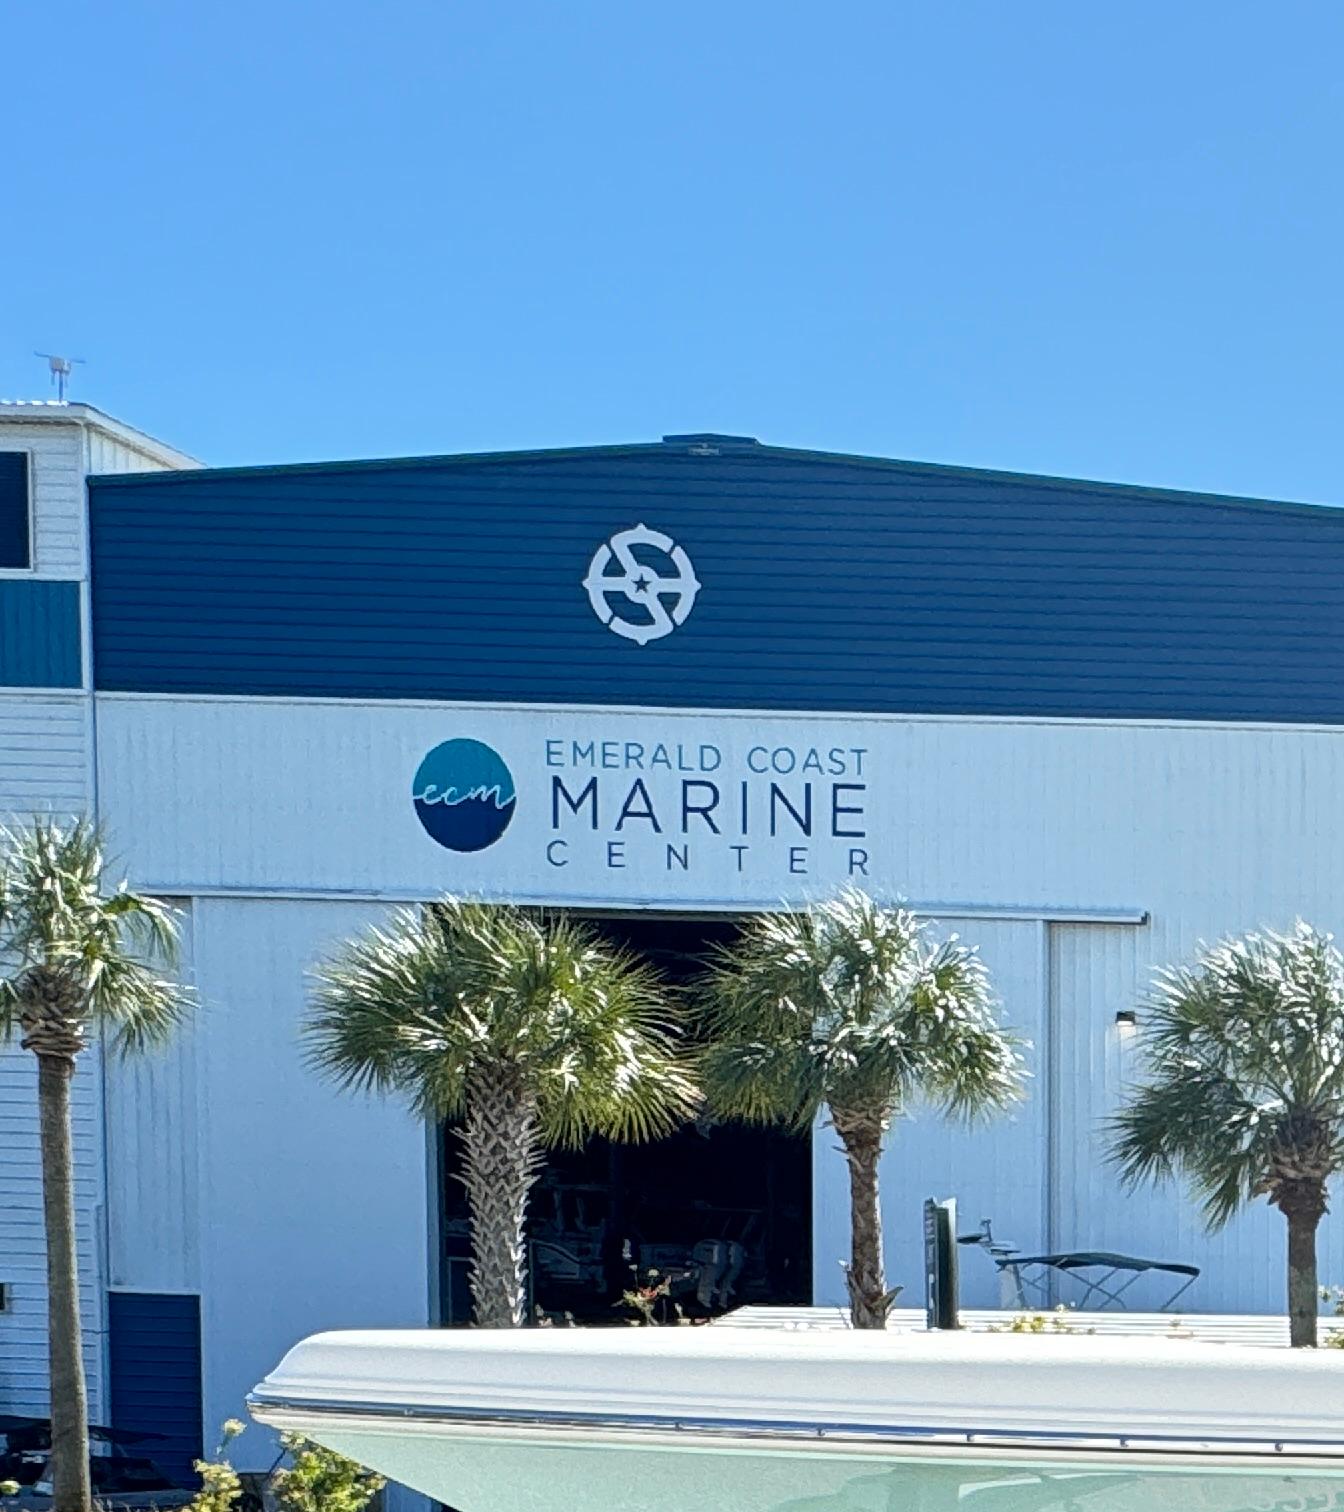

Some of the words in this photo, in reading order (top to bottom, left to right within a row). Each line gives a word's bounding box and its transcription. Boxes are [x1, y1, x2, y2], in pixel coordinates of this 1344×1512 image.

[546, 740, 721, 772] EMERALD
[748, 748, 868, 776] COAST
[552, 775, 867, 838] MARINE
[546, 840, 869, 876] CENTER
